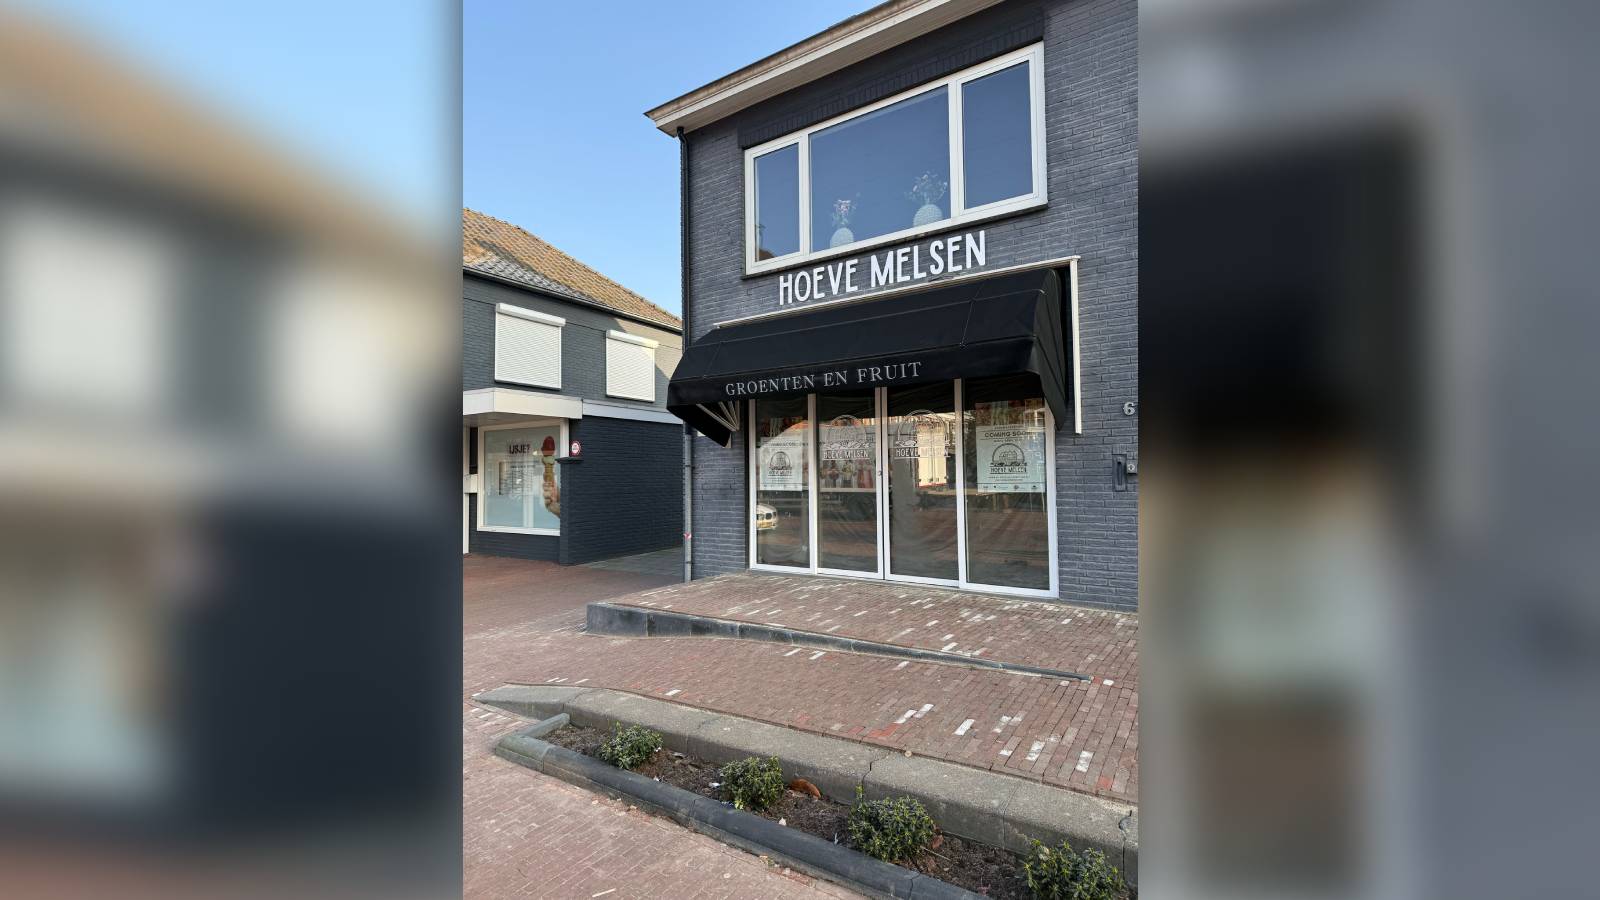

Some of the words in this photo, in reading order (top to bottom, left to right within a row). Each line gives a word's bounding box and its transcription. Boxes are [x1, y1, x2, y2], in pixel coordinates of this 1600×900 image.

[779, 259, 858, 306] HOEVE
[871, 230, 986, 288] MELSEN
[725, 374, 815, 396] GROENTEN
[824, 370, 848, 387] EN
[857, 361, 922, 384] FRUIT
[1123, 402, 1136, 416] 6
[509, 444, 531, 455] IJSJE?
[896, 447, 918, 457] HOEVE
